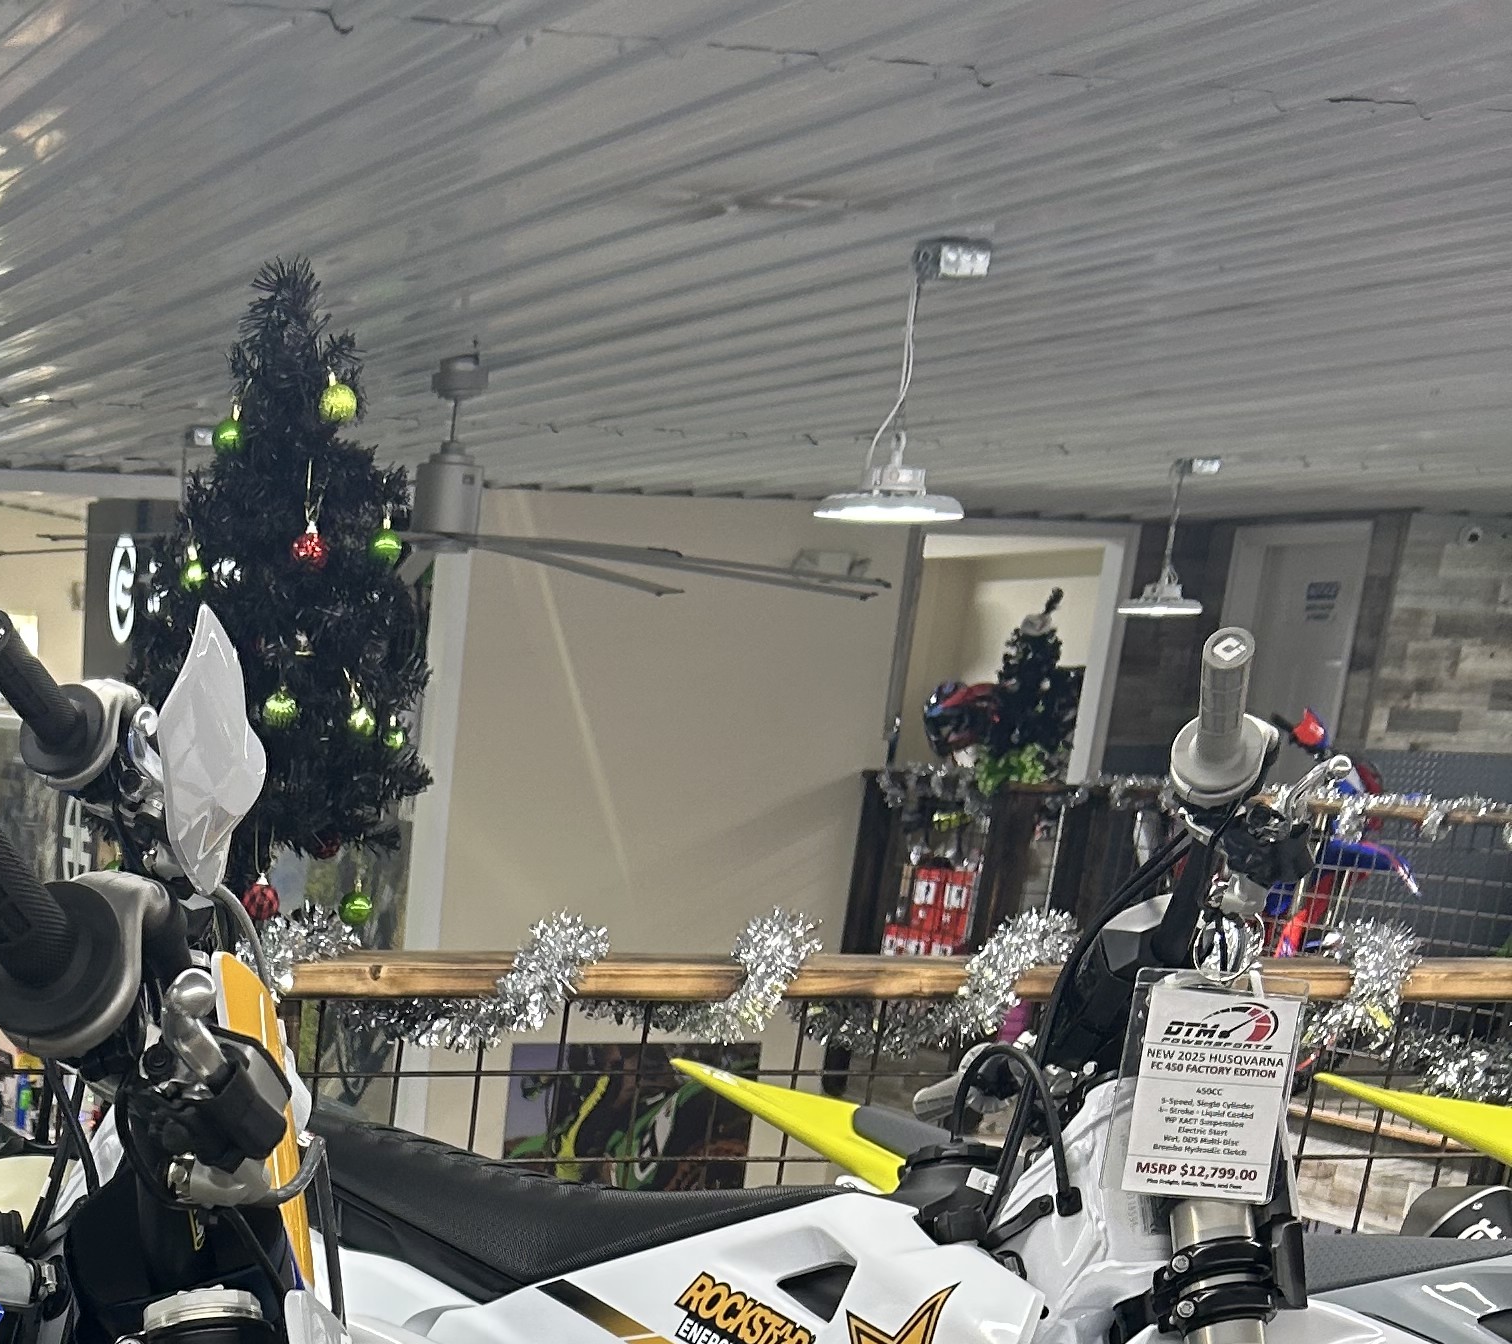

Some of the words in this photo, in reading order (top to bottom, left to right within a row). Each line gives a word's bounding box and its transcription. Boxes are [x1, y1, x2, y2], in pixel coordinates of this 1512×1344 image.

[1163, 1020, 1220, 1039] DTM
[1161, 1037, 1273, 1051] POWERSPORTS
[1146, 1048, 1175, 1060] NEW
[1178, 1050, 1206, 1063] 2025
[1208, 1053, 1284, 1068] HUSQVARNA
[1150, 1061, 1163, 1070] FC
[1164, 1062, 1184, 1073] 450
[1186, 1063, 1231, 1075] FACTORY
[1233, 1066, 1276, 1079] EDITION
[1135, 1161, 1177, 1175] MSRP
[1179, 1163, 1258, 1181] $12,799.00
